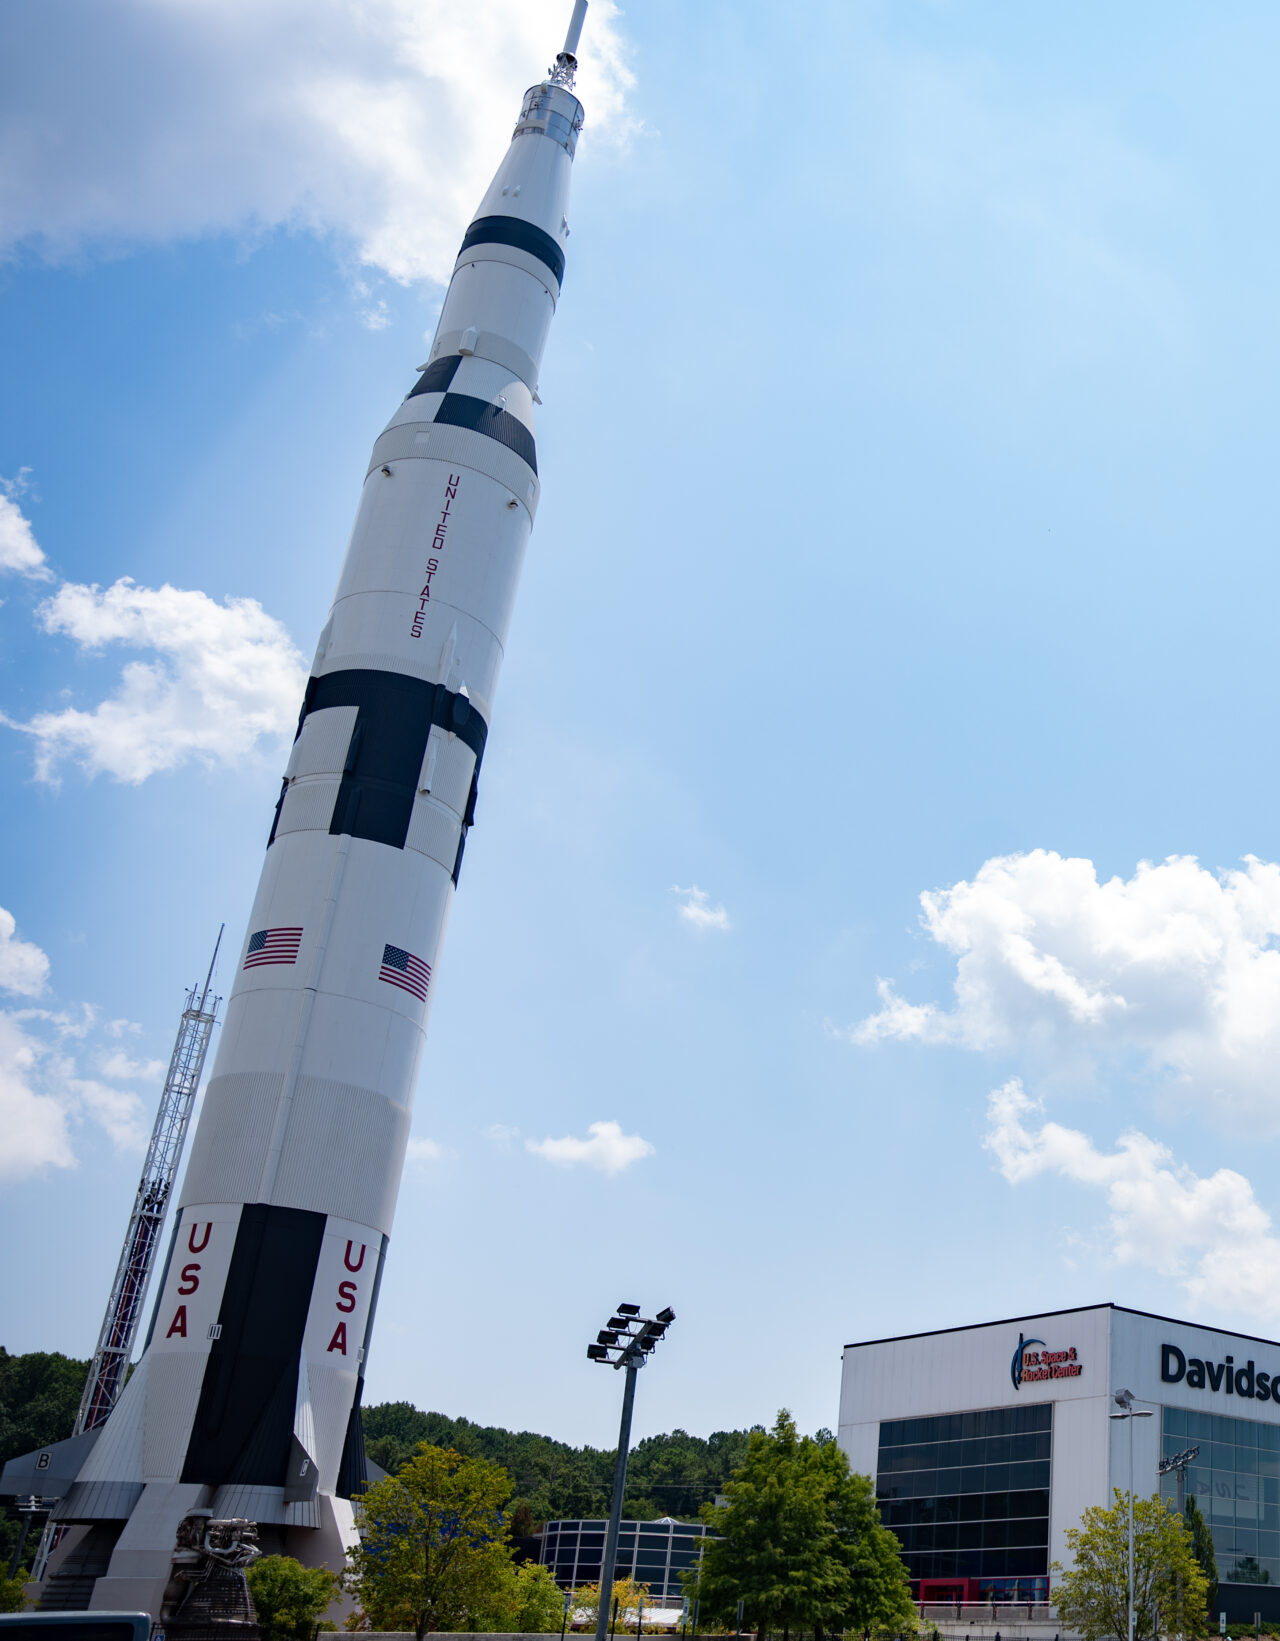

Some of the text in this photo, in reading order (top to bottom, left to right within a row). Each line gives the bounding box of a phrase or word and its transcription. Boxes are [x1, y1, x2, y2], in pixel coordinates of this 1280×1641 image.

[410, 474, 460, 638] UNITED STATES
[166, 1222, 213, 1338] USA
[326, 1239, 366, 1356] USA
[1022, 1364, 1082, 1381] Rocket Center
[1023, 1347, 1077, 1366] U.S. Space &
[38, 1453, 50, 1468] B
